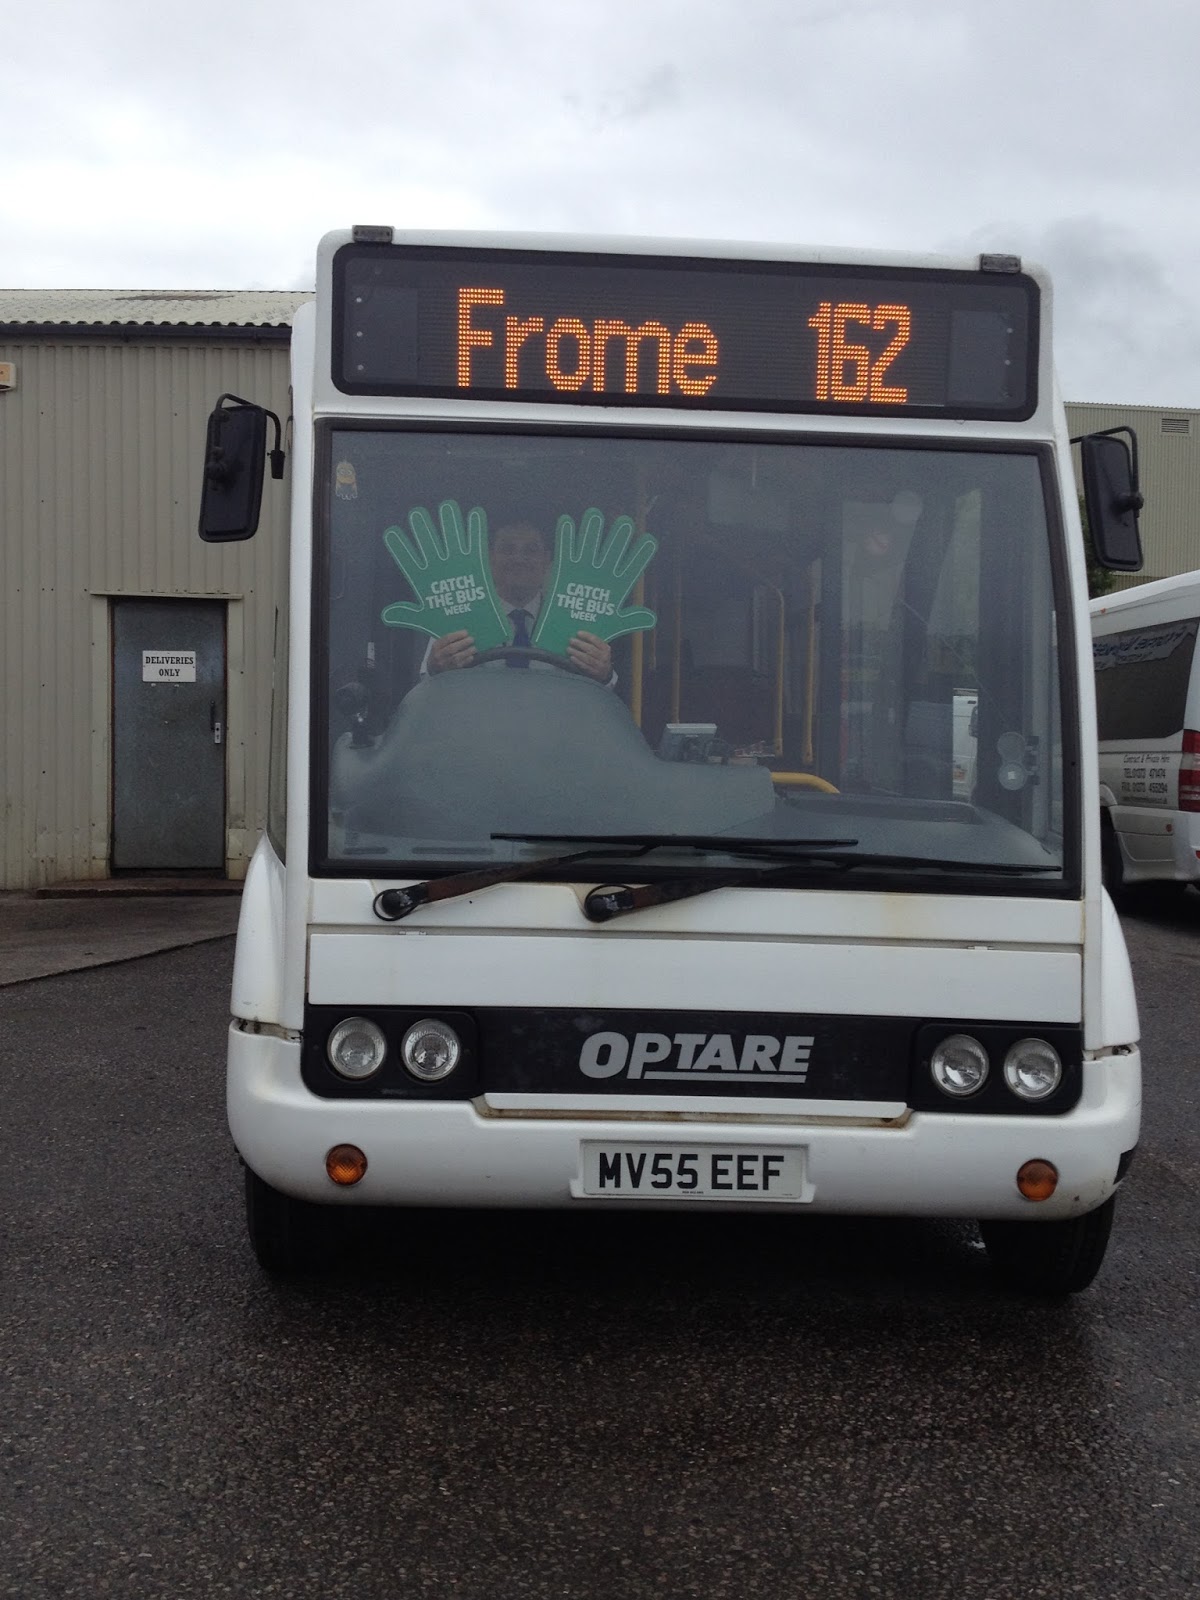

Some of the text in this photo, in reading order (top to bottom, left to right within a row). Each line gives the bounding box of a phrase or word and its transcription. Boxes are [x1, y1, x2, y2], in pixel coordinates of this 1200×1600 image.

[458, 288, 911, 404] Frome 162
[430, 574, 475, 595] CATCH
[566, 582, 610, 602] CATCH
[425, 586, 486, 609] THE BUS
[556, 593, 615, 616] THE BUS
[443, 602, 472, 616] WEEK
[570, 609, 597, 622] WEEK
[145, 656, 194, 665] DELIVERIES
[158, 668, 181, 677] ONLY
[578, 1031, 815, 1083] OPTARE
[599, 1153, 784, 1190] MV55 EEF
